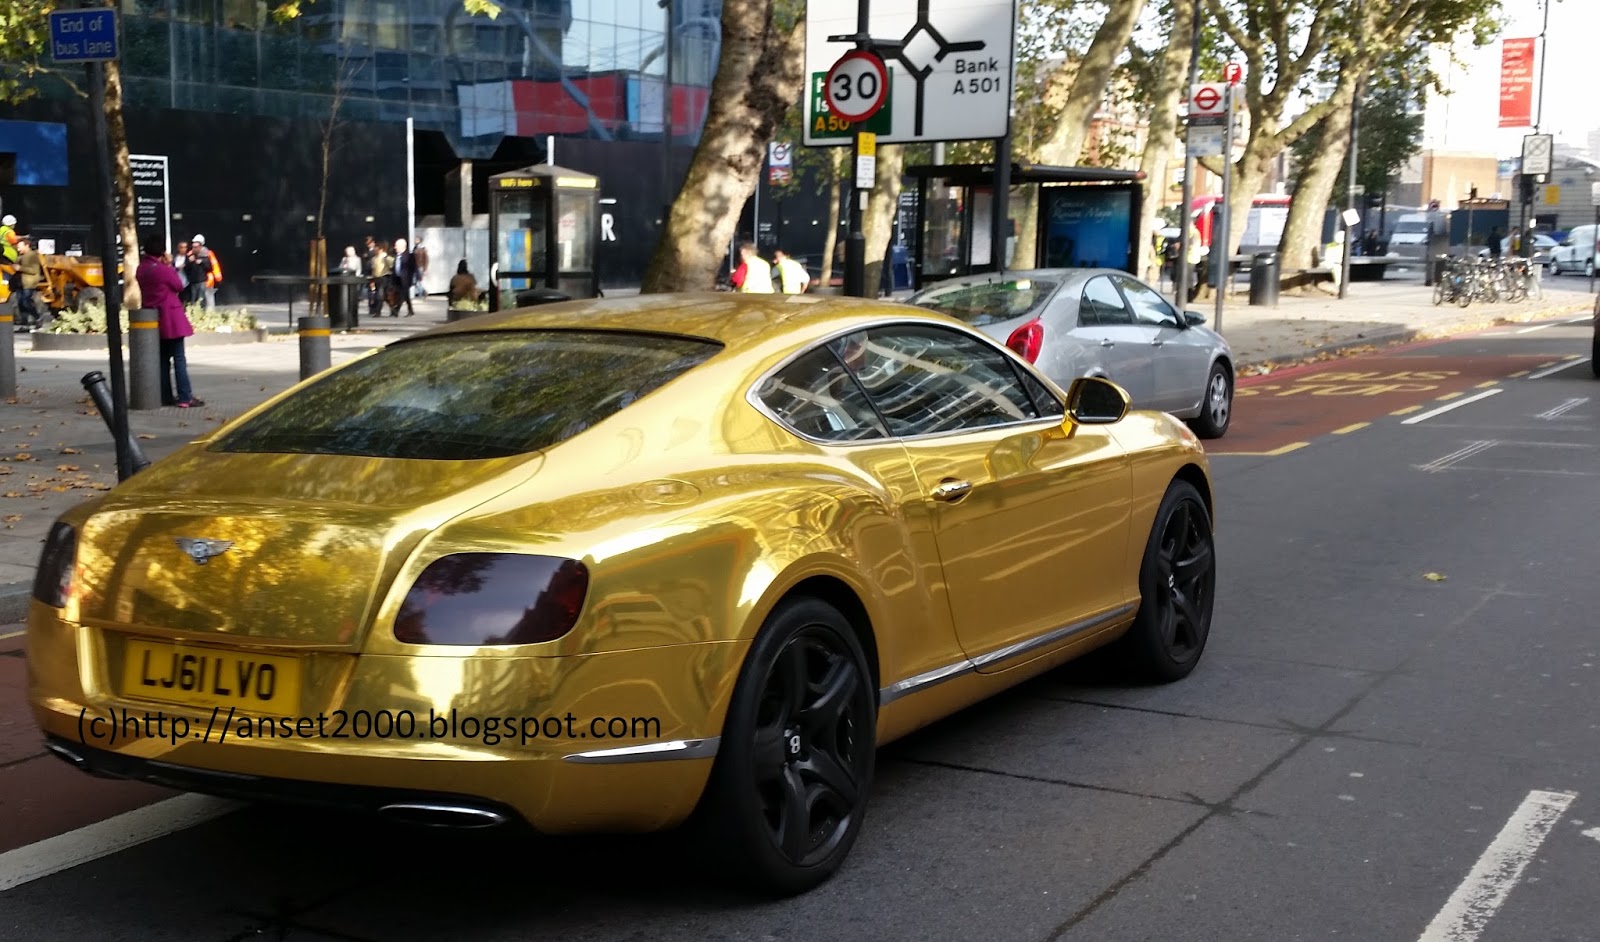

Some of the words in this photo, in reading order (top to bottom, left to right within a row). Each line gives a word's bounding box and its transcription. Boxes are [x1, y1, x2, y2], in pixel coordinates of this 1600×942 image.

[60, 16, 84, 33] End
[89, 15, 103, 32] of
[56, 40, 79, 55] bus
[83, 39, 112, 54] lane
[955, 57, 998, 74] Bank
[1226, 64, 1239, 80] F
[833, 71, 878, 102] 30
[141, 650, 207, 692] LJ61
